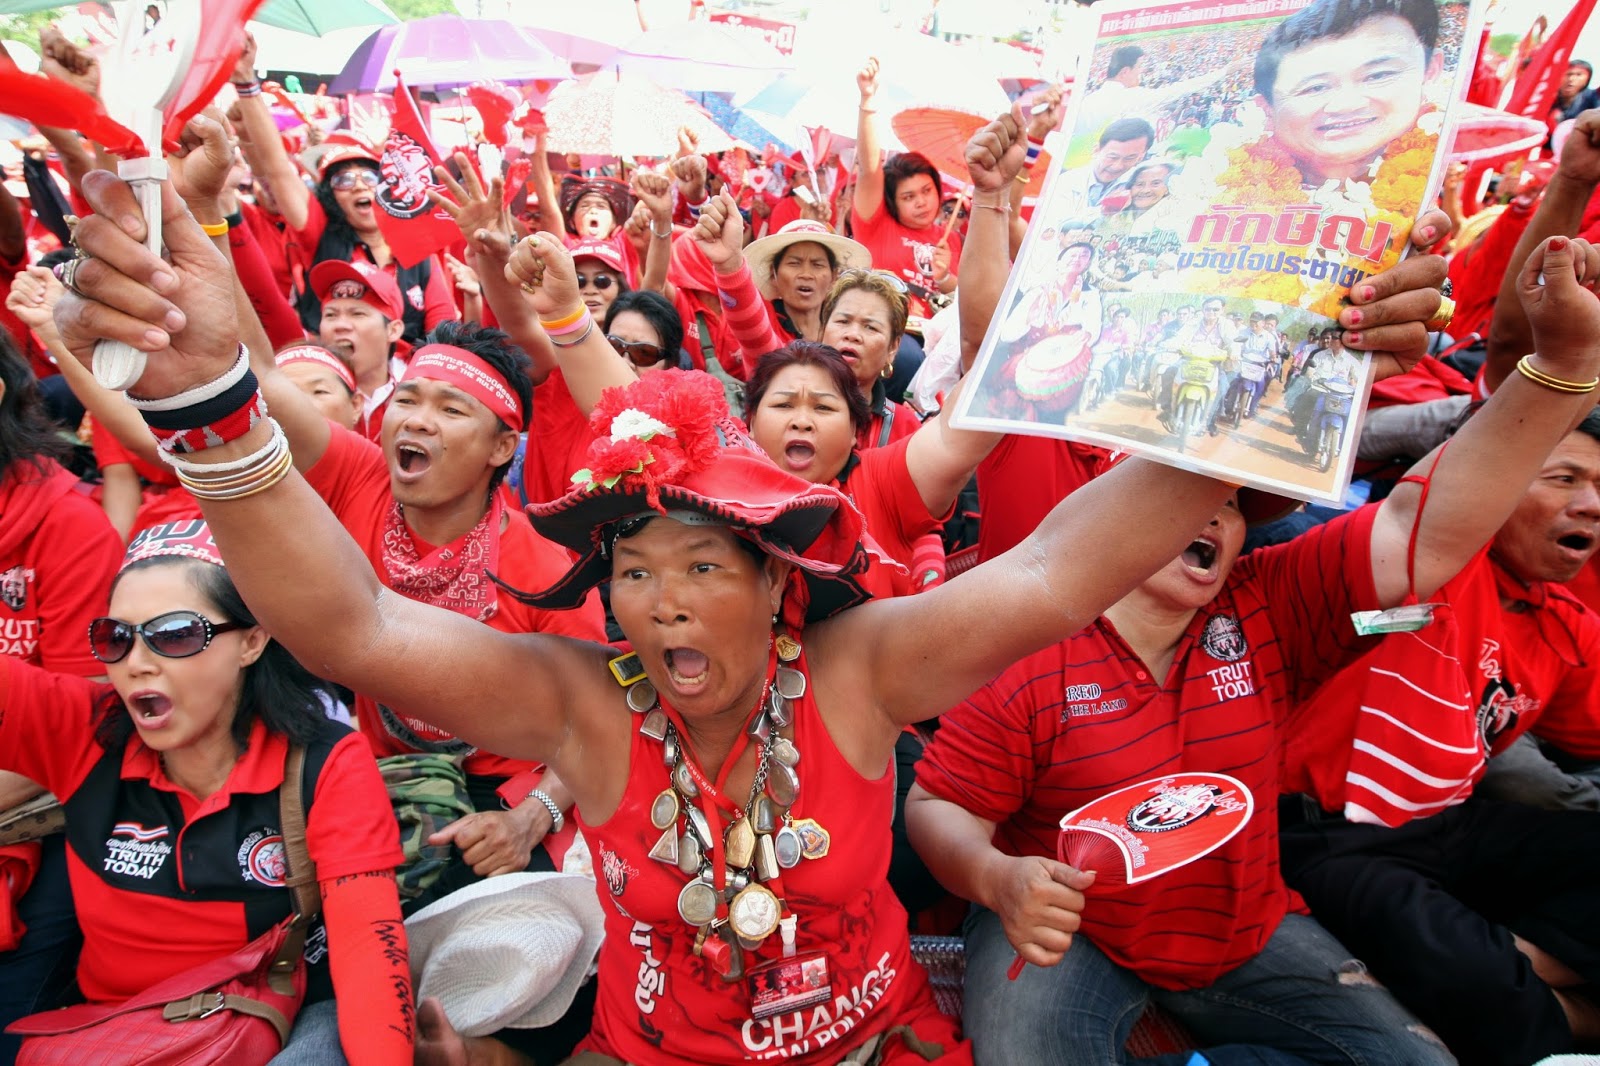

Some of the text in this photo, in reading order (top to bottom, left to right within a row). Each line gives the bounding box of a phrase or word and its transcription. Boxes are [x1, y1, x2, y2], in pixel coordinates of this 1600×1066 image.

[1187, 204, 1393, 264] ทักษิณ
[446, 363, 458, 371] OF
[460, 367, 474, 379] THE
[476, 376, 495, 393] RULE
[496, 391, 504, 400] OF
[0, 617, 40, 640] RUT
[1066, 683, 1102, 702] RED
[1091, 698, 1128, 716] LAND
[108, 847, 167, 867] TRUTH
[103, 858, 160, 880] TODAY
[741, 951, 891, 1052] CHANGE
